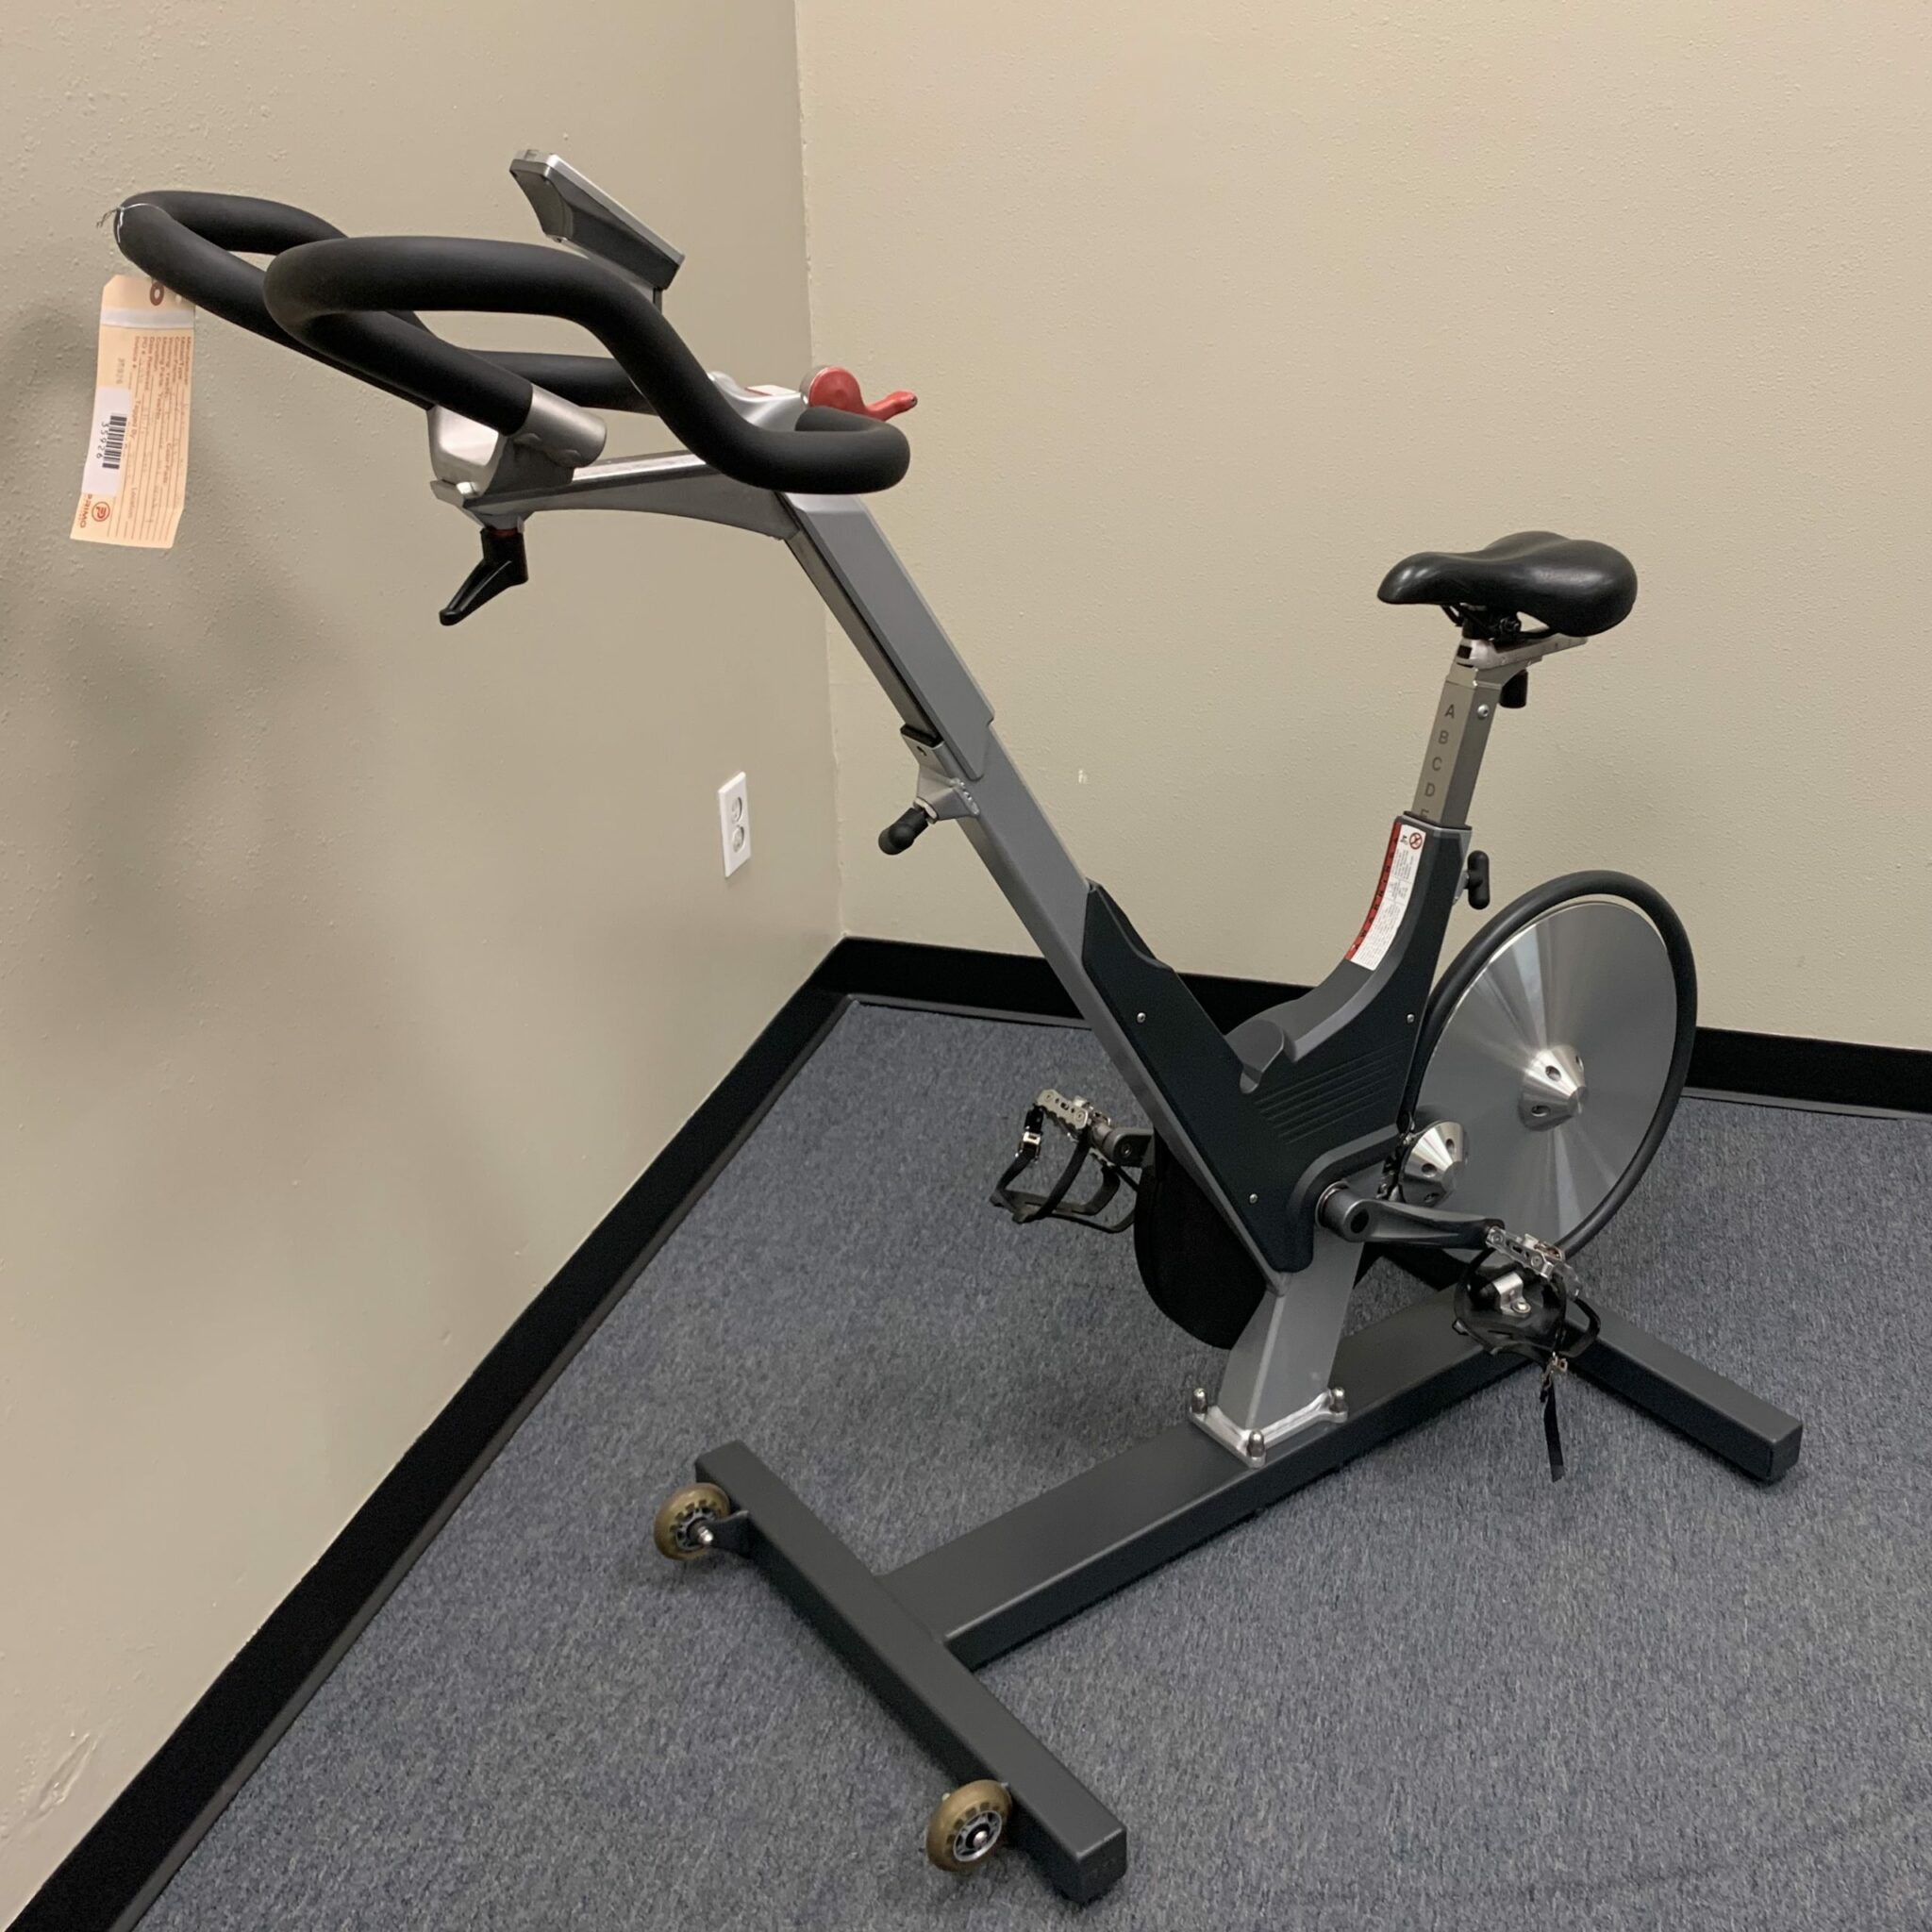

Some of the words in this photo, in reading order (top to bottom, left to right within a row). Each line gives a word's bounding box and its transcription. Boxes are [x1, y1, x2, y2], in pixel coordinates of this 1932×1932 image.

[95, 422, 108, 459] 35926
[79, 492, 93, 529] PRIMO
[1444, 704, 1455, 719] A
[1438, 730, 1449, 744] B
[1431, 757, 1442, 772] C
[1424, 782, 1436, 797] D
